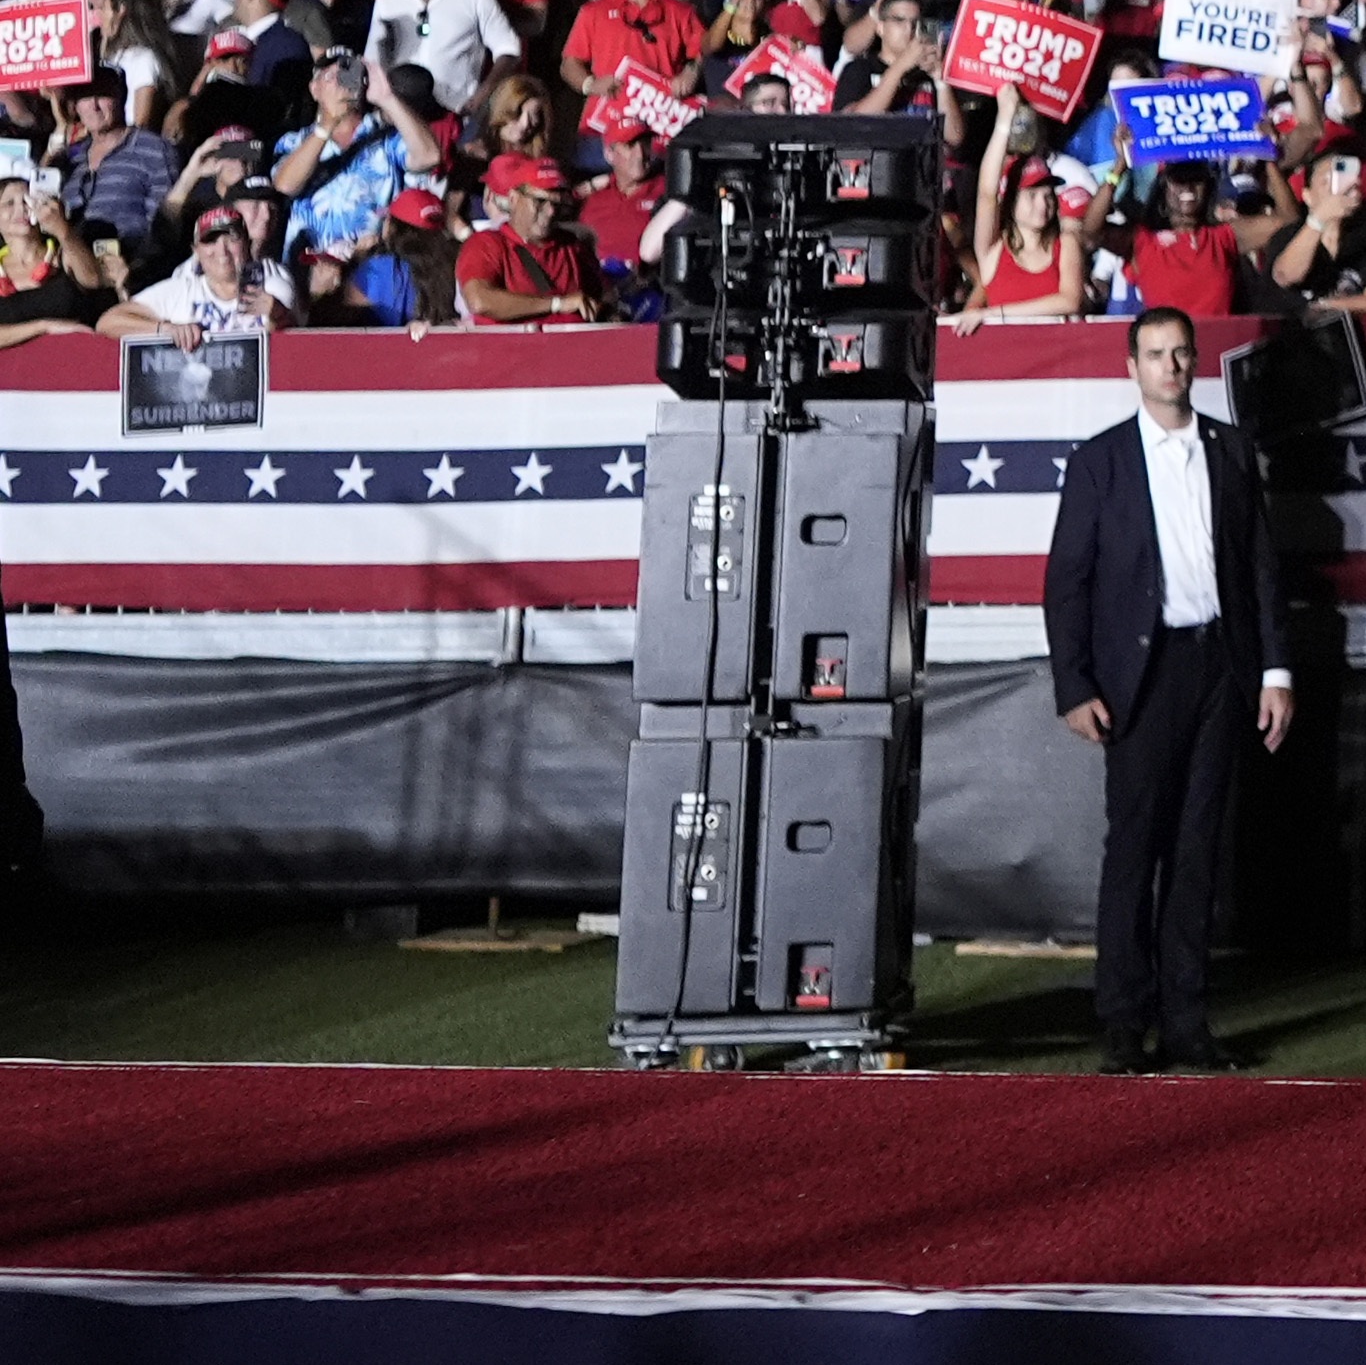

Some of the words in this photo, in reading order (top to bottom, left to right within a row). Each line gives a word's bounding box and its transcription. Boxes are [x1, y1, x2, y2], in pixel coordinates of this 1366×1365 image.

[0, 11, 77, 44] RUMP
[973, 9, 1086, 64] TRUMP
[1175, 18, 1280, 55] FIRED!
[979, 36, 1063, 84] 2024
[1130, 90, 1250, 119] TRUMP
[1154, 110, 1241, 135] 2024
